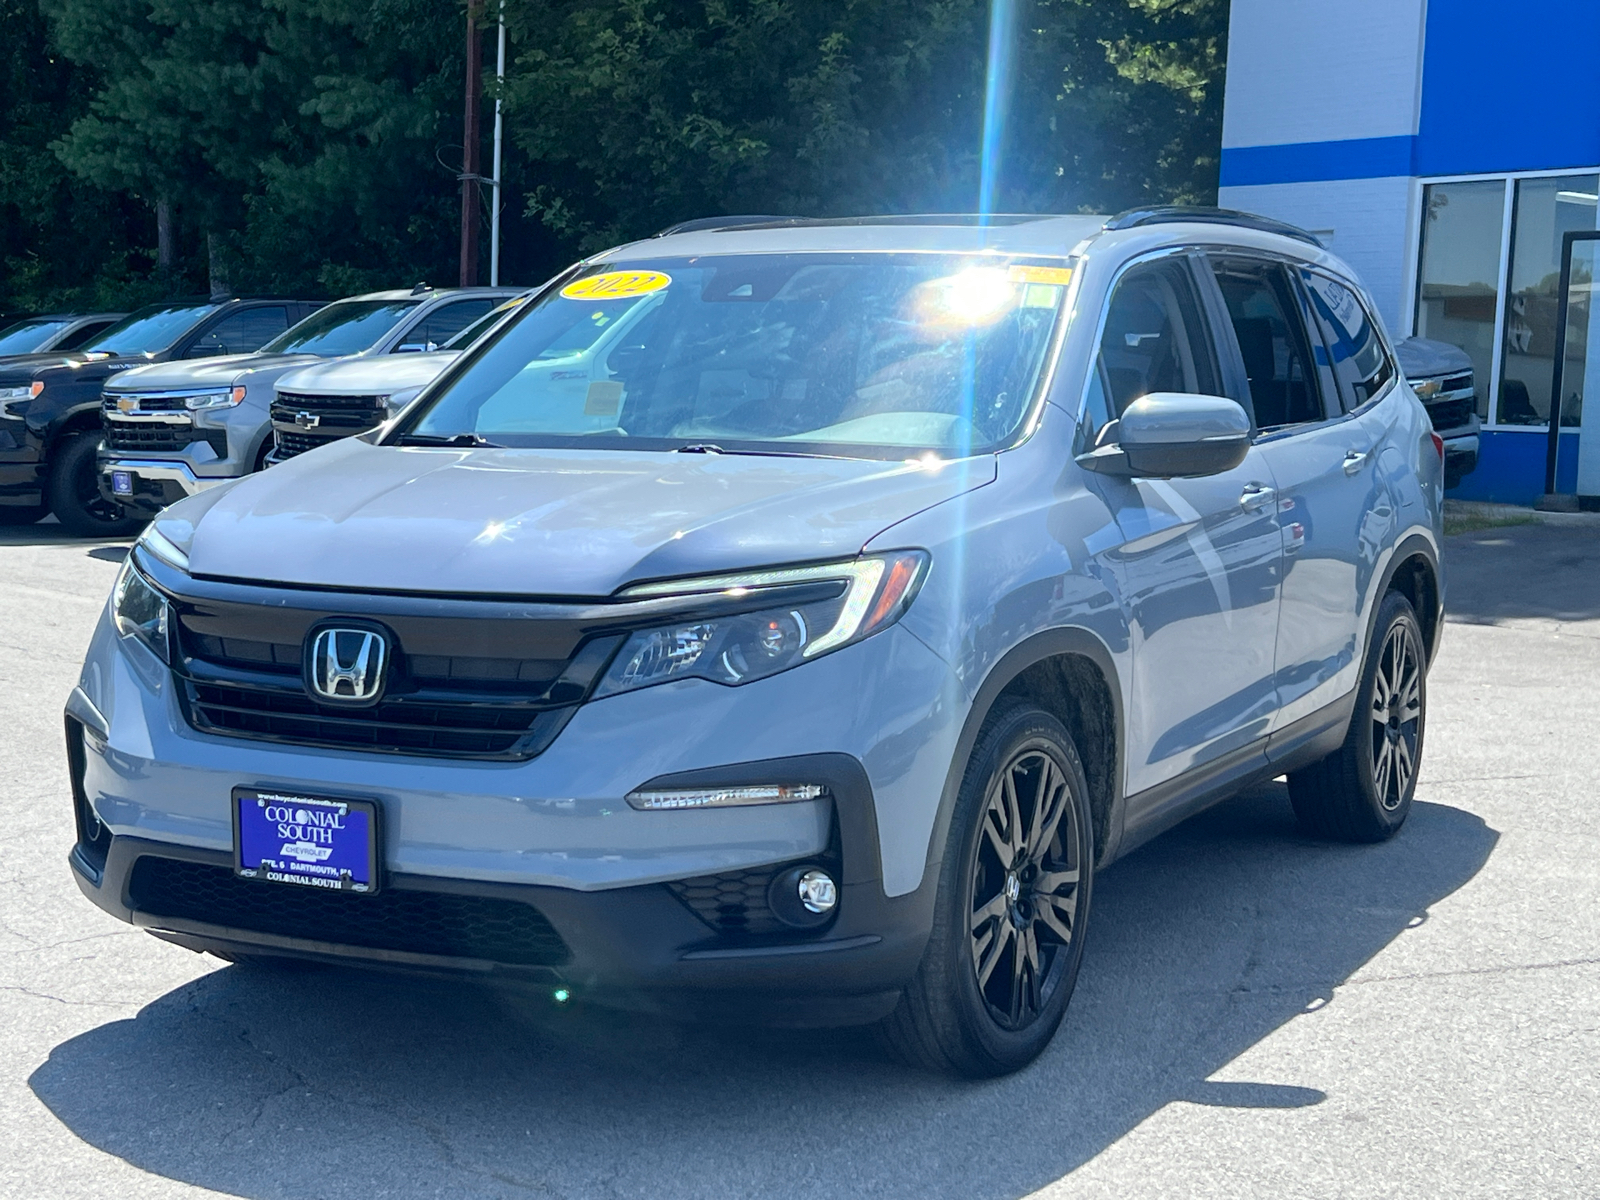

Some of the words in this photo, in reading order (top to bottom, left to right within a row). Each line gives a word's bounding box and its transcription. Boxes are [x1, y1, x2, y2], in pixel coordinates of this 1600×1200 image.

[573, 276, 656, 294] 2022
[265, 806, 345, 829] COLONIAL
[277, 823, 333, 844] SOUTH
[285, 846, 328, 857] CHEVROLET
[290, 862, 339, 877] DARTMOUTH,
[267, 872, 311, 885] COLONIAL
[312, 877, 342, 889] SOUTH
